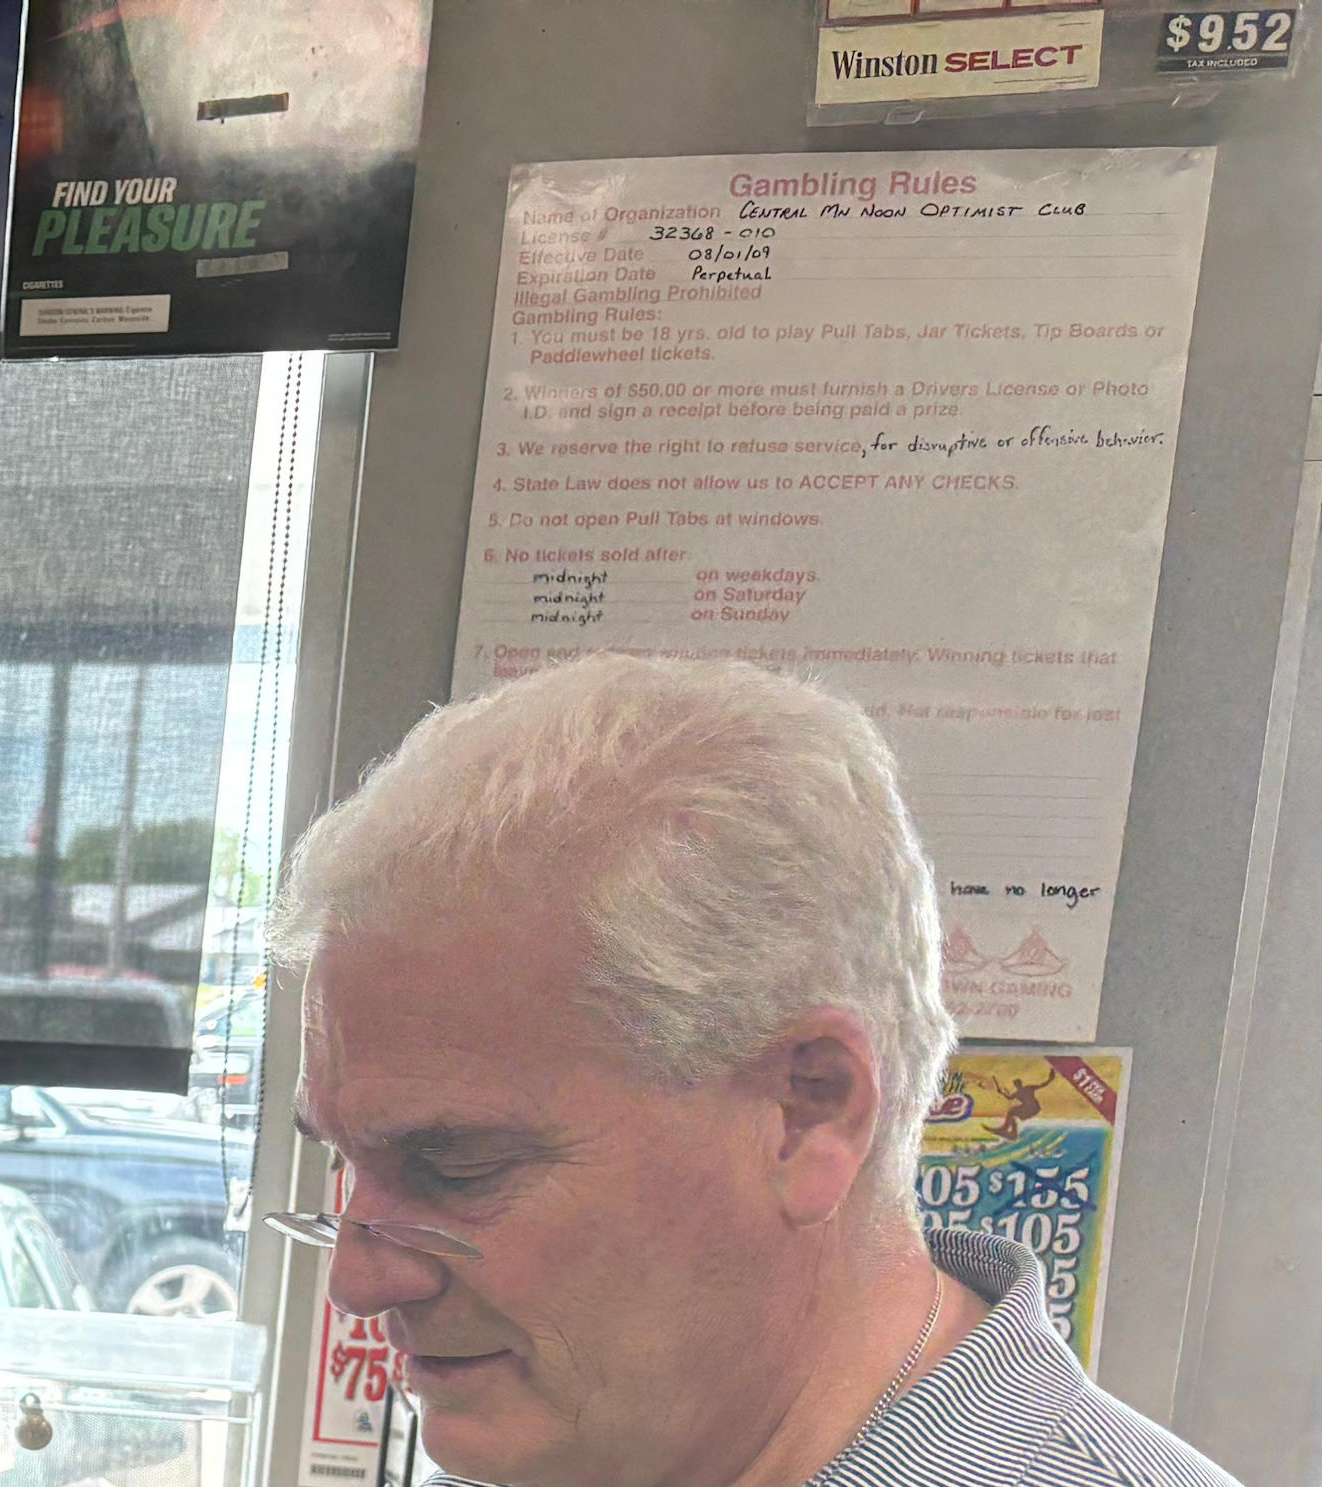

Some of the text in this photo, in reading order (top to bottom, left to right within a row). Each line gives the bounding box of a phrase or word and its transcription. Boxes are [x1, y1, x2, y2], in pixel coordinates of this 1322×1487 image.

[1165, 12, 1291, 54] $9.52
[831, 44, 1083, 80] Winston SELECT
[53, 177, 177, 207] FIND YOUR
[729, 171, 977, 201] Gambling Rules
[604, 205, 721, 224] Organization
[920, 203, 1024, 217] OPTIMIST
[1037, 203, 1086, 216] CLUB
[32, 201, 266, 256] PLEASURE
[649, 227, 714, 241] 32368
[604, 248, 644, 262] Date
[516, 267, 656, 286] Expiration Date
[693, 266, 771, 283] Perpetual
[514, 284, 762, 308] Illegal Gambling Prohibited
[512, 307, 662, 327] Gambling Rules:
[532, 329, 564, 344] You
[570, 329, 615, 343] must
[622, 327, 643, 341] be
[651, 326, 670, 341] 18
[677, 328, 710, 345] yrs.
[717, 326, 745, 340] old
[752, 326, 770, 340] to
[776, 325, 814, 342] play
[821, 324, 856, 339] Pull
[865, 323, 910, 340] Tabs,
[918, 323, 947, 339] Jar
[954, 323, 1025, 339] Tickets,
[1034, 323, 1063, 341] Tip
[1069, 323, 1138, 338] Boards
[1144, 325, 1165, 338] or
[530, 346, 715, 365] Paddlewheel tickets.
[513, 477, 559, 492] State
[565, 476, 602, 491] Law
[608, 475, 652, 491] does
[658, 476, 688, 490] not
[693, 475, 741, 490] allow
[747, 477, 770, 490] us
[776, 475, 793, 490] to
[800, 475, 879, 490] ACCEPT
[884, 475, 925, 490] ANY
[931, 475, 1020, 490] CHECKS.
[505, 549, 529, 563] No
[536, 549, 594, 563] tickets
[601, 548, 638, 562] sold
[646, 548, 687, 562] after
[533, 570, 607, 589] midnight
[696, 571, 719, 582] on
[534, 591, 605, 609] midnight
[693, 588, 806, 607] on Saturday
[531, 611, 604, 627] midnight
[691, 607, 790, 624] on Sunday
[1005, 885, 1025, 896] no
[1042, 882, 1100, 910] longer
